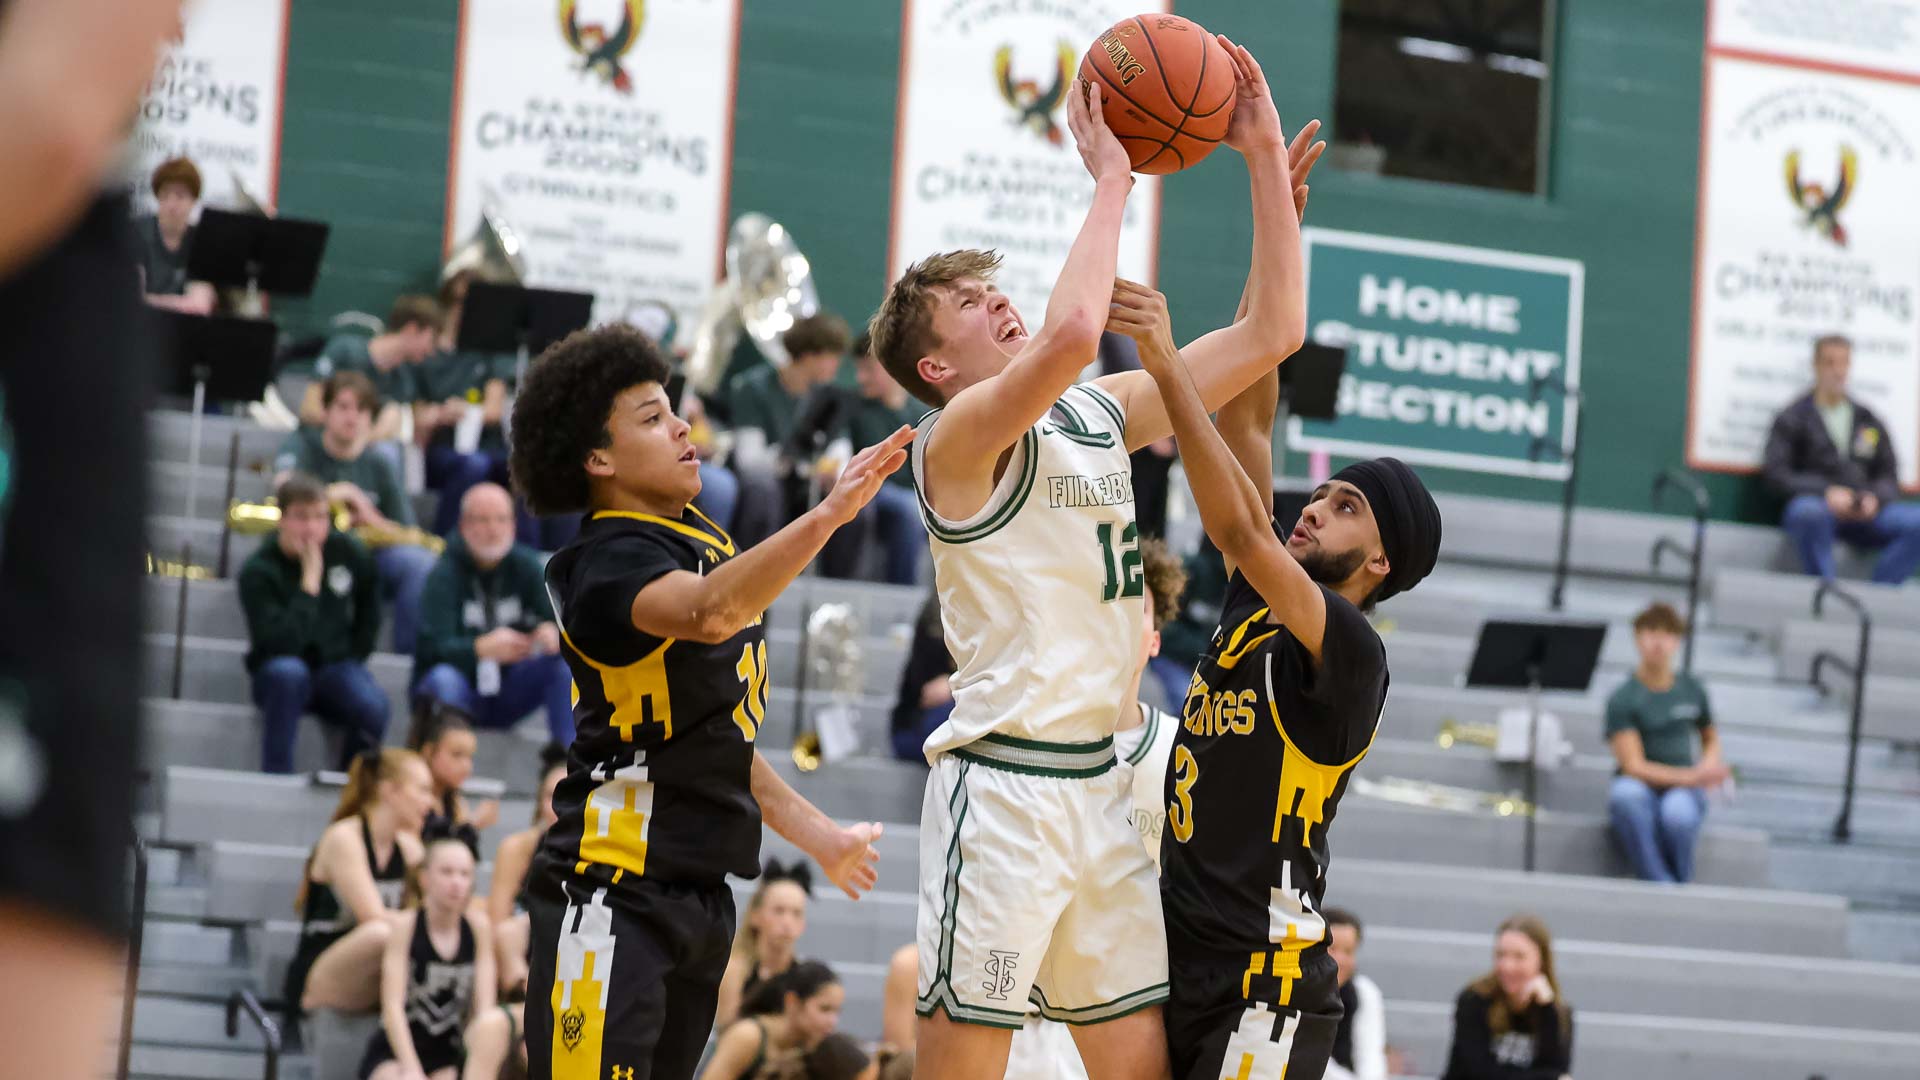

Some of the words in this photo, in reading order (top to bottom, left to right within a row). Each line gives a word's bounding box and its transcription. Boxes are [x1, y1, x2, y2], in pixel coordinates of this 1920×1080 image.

[476, 110, 709, 177] CHAMPIONS
[1356, 273, 1522, 335] HOME
[1095, 519, 1144, 604] 12
[732, 638, 770, 742] 10
[1168, 742, 1199, 844] 3
